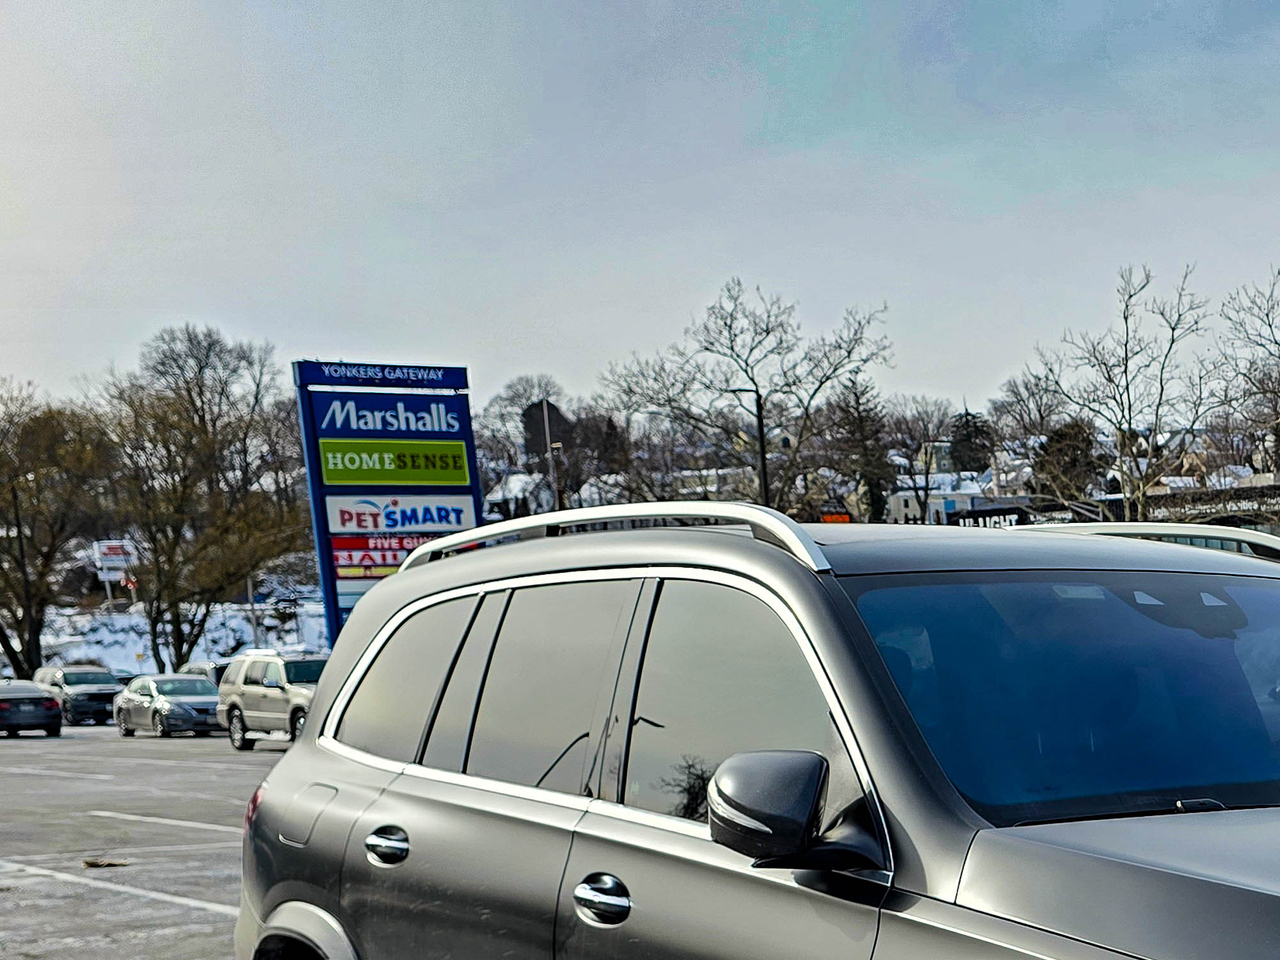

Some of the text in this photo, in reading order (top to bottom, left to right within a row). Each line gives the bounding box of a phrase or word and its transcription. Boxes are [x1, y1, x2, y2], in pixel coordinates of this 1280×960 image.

[321, 364, 444, 381] YONKERS GATEWAY
[321, 400, 460, 433] Marshalls
[325, 452, 464, 471] HOMESENSE
[339, 506, 464, 529] PETSMART
[368, 537, 437, 549] FIVE GU
